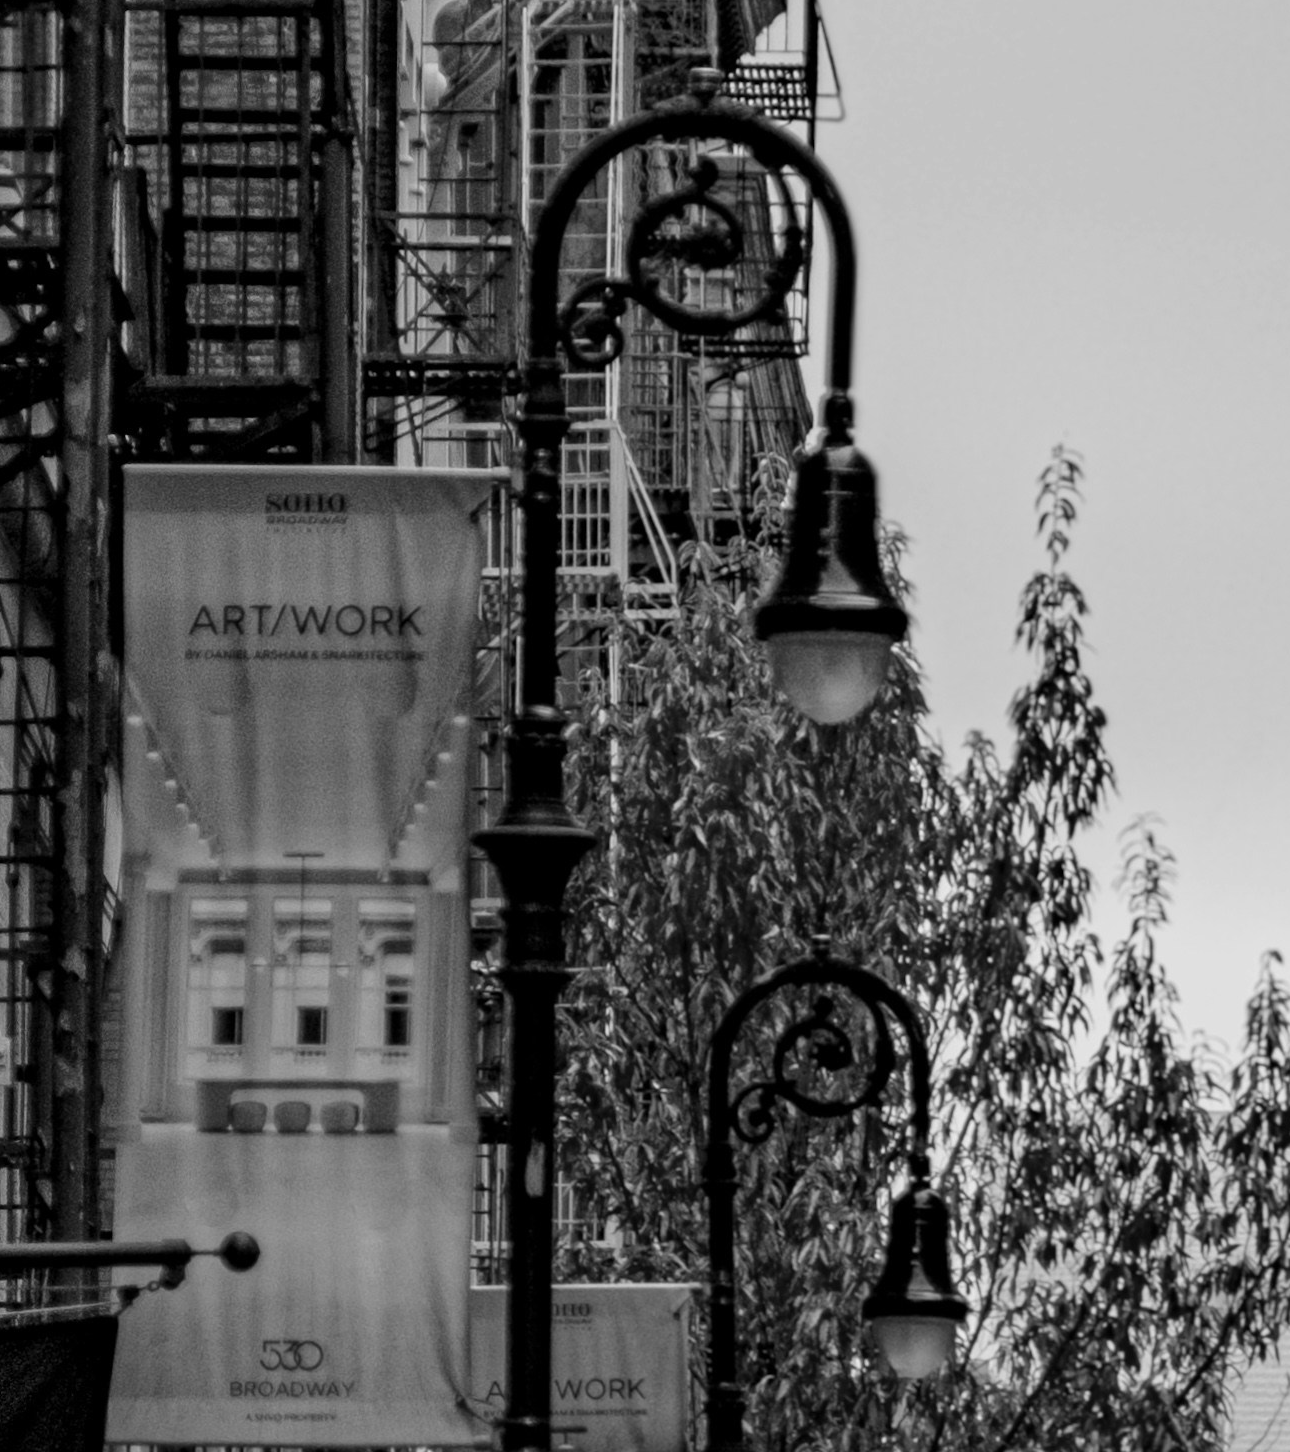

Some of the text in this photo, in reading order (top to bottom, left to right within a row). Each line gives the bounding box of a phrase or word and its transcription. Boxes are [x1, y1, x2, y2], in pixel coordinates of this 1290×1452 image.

[188, 604, 423, 637] ART/WORK
[259, 1340, 324, 1371] 530
[229, 1380, 356, 1398] BROADWAY
